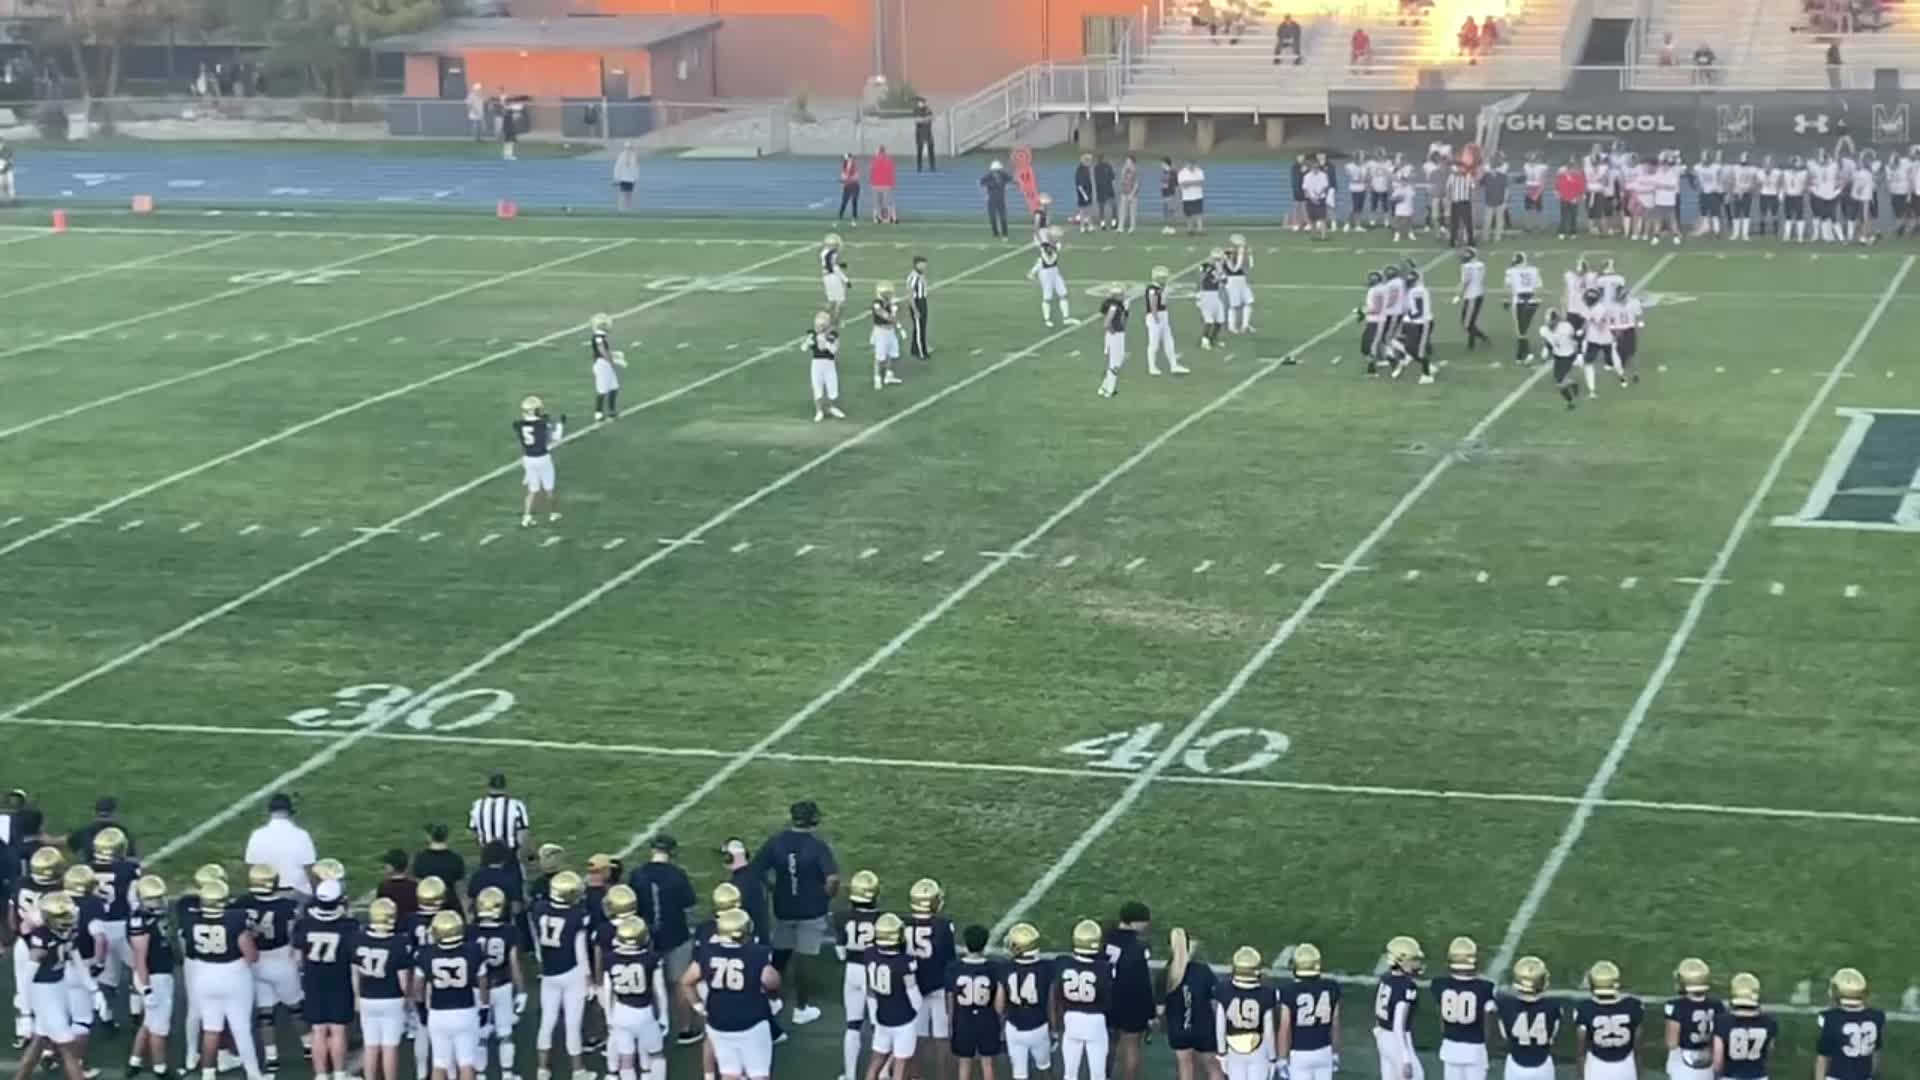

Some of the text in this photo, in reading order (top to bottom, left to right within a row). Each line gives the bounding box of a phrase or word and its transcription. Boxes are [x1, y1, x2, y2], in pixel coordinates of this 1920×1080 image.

[1350, 113, 1464, 131] MULLEN
[1555, 113, 1675, 132] SCHOOL
[520, 425, 536, 446] 5
[286, 683, 515, 730] 30
[1060, 722, 1290, 775] 40
[306, 931, 340, 963] 77
[539, 914, 566, 948] 17
[845, 920, 876, 952] 12
[904, 926, 933, 959] 15
[356, 946, 389, 978] 37
[431, 957, 468, 989] 53
[610, 962, 646, 995] 20
[709, 956, 745, 991] 76
[955, 975, 991, 1006] 36
[1007, 973, 1038, 1005] 14
[1062, 968, 1098, 1003] 26
[1226, 997, 1260, 1029] 49
[1296, 990, 1331, 1026] 24
[1441, 989, 1477, 1024] 80
[1511, 1011, 1548, 1046] 44
[1592, 1014, 1631, 1047] 25
[1729, 1027, 1768, 1061] 87
[1841, 1021, 1878, 1057] 32
